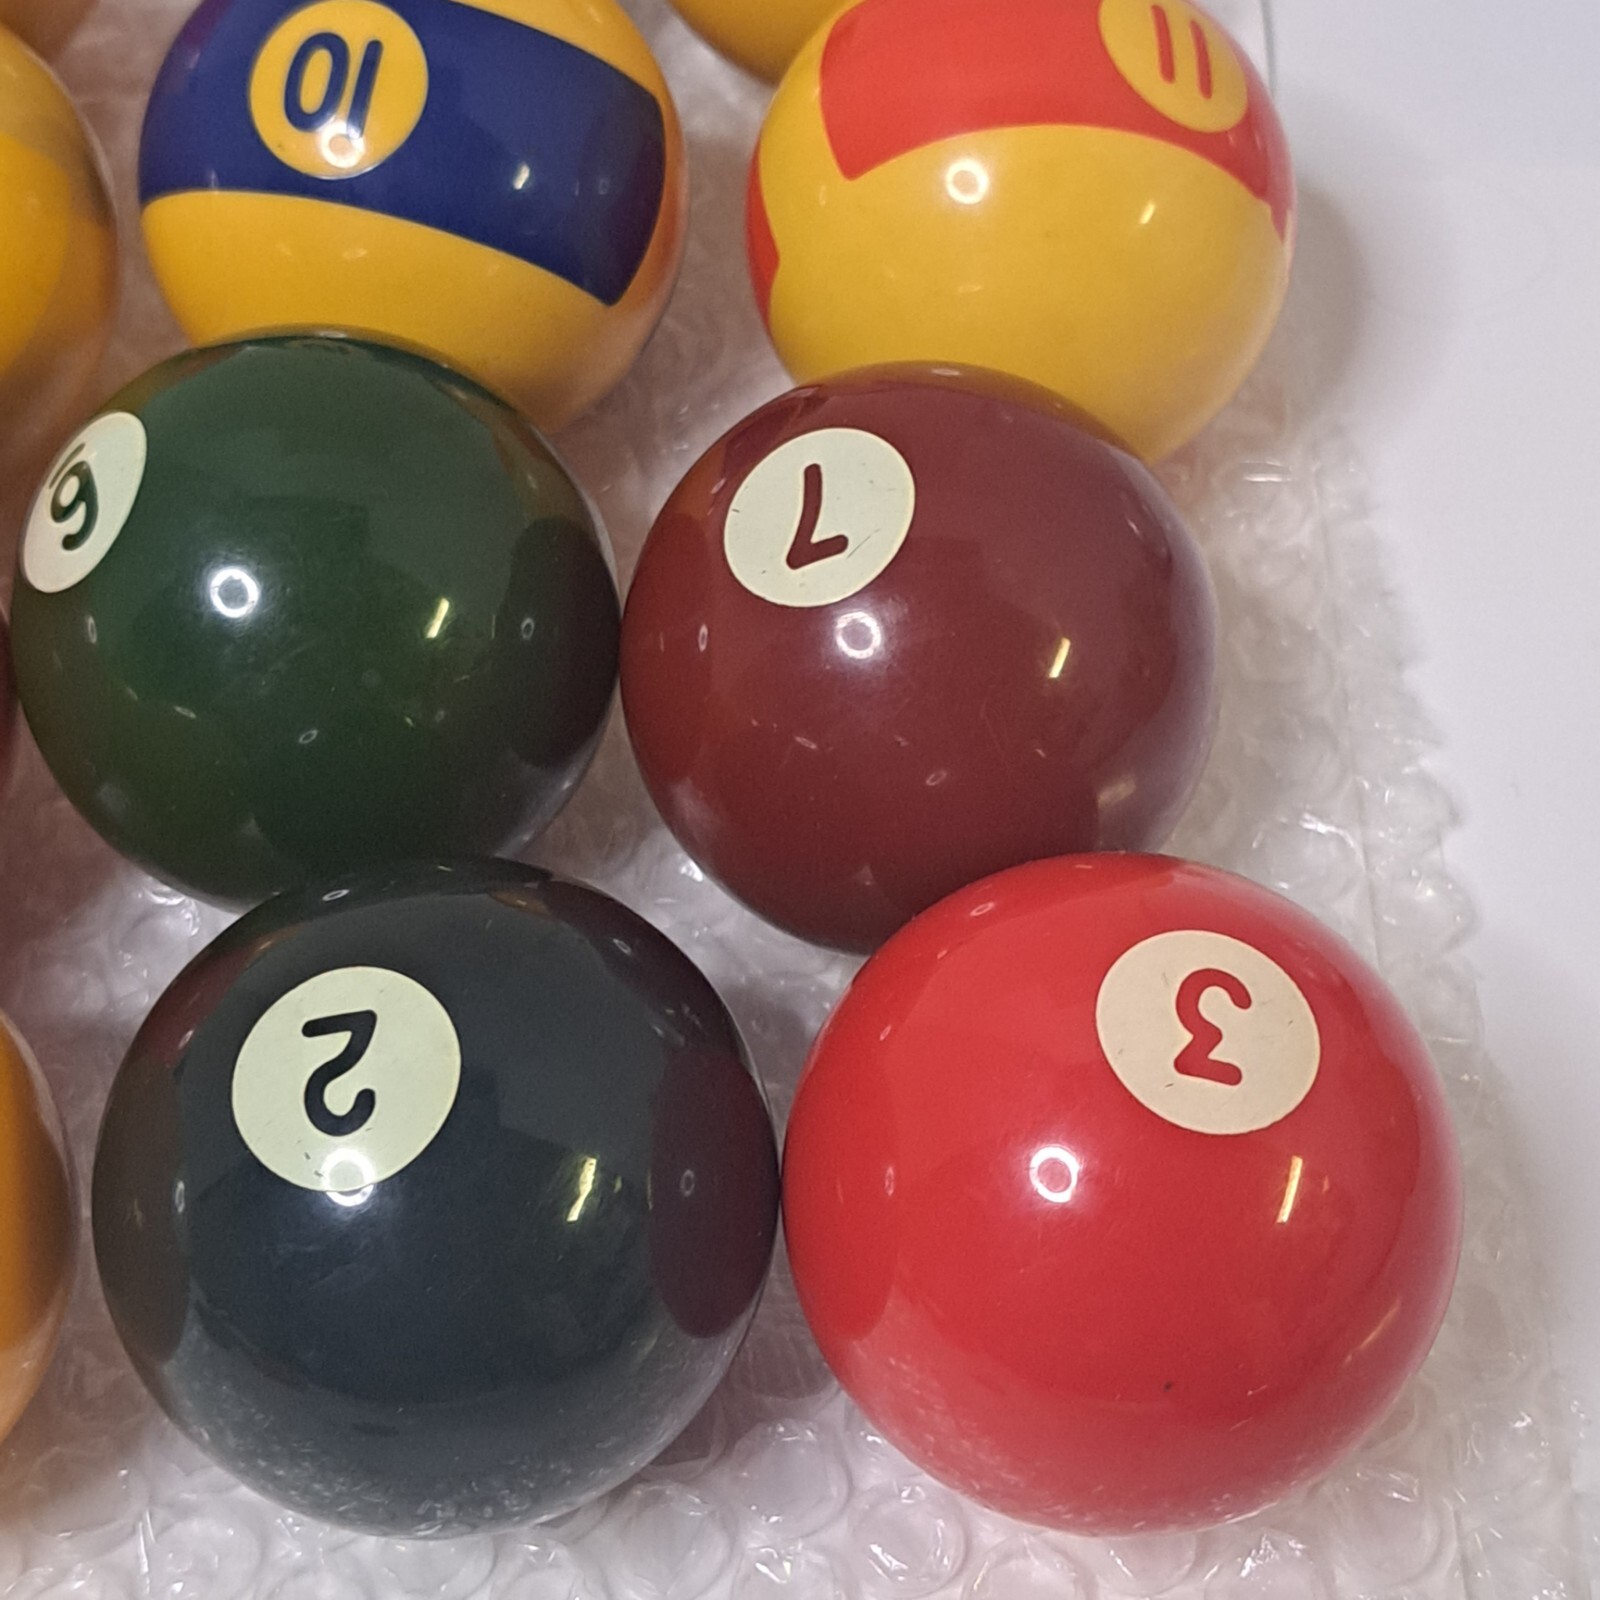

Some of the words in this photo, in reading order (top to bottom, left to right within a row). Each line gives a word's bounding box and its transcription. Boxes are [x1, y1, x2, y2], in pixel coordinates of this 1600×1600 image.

[284, 31, 383, 139] 10
[1151, 5, 1212, 99] 11
[786, 463, 848, 570] 7
[302, 1010, 377, 1137] 2
[1174, 968, 1252, 1086] 3
